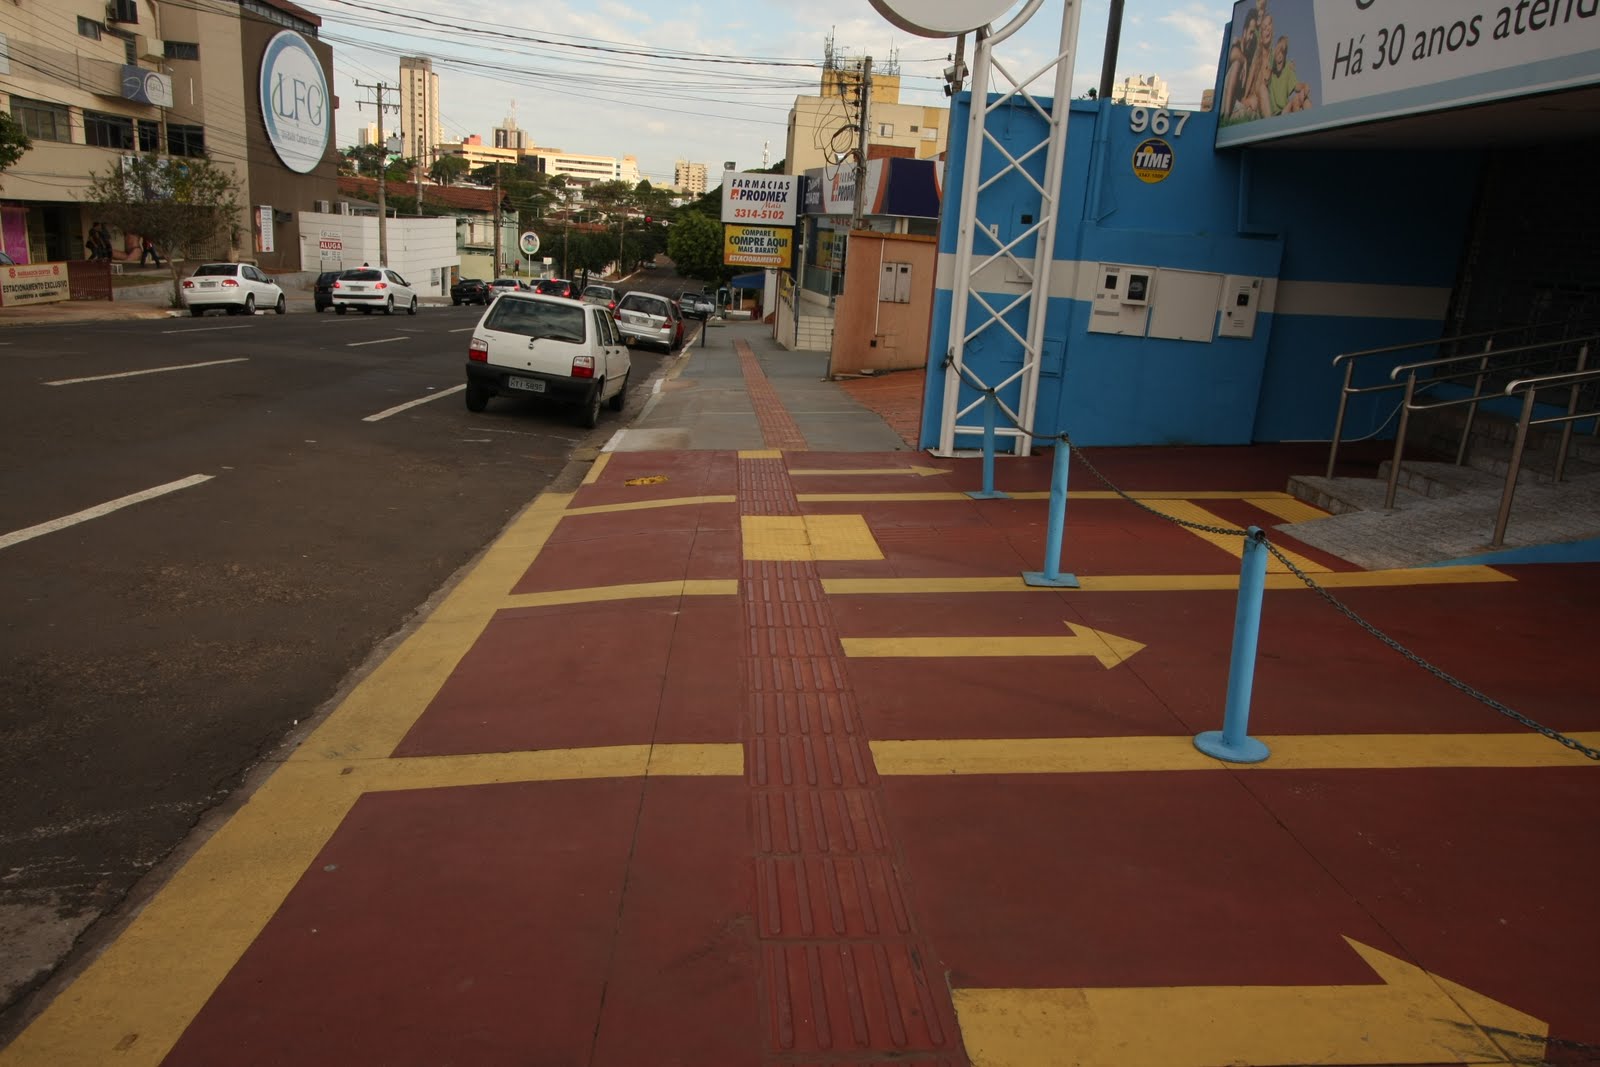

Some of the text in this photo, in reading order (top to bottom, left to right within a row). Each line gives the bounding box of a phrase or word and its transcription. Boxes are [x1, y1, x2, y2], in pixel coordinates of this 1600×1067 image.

[1332, 34, 1366, 80] Há
[1372, 24, 1406, 70] 30
[1411, 14, 1483, 61] anos
[1130, 106, 1191, 136] 967
[1135, 151, 1172, 169] TIME
[731, 178, 790, 191] FARMÁCIAS
[739, 189, 788, 203] PRODMEX
[761, 202, 782, 211] Mais
[734, 208, 784, 220] 3314-5102
[741, 229, 771, 237] COMPARE
[320, 241, 342, 250] ALUGA
[729, 236, 788, 248] COMPRE AQUI
[729, 255, 782, 264] ESTACIONAMENTO
[3, 280, 67, 293] ESTACIONAMENTO EXCLUSIVO
